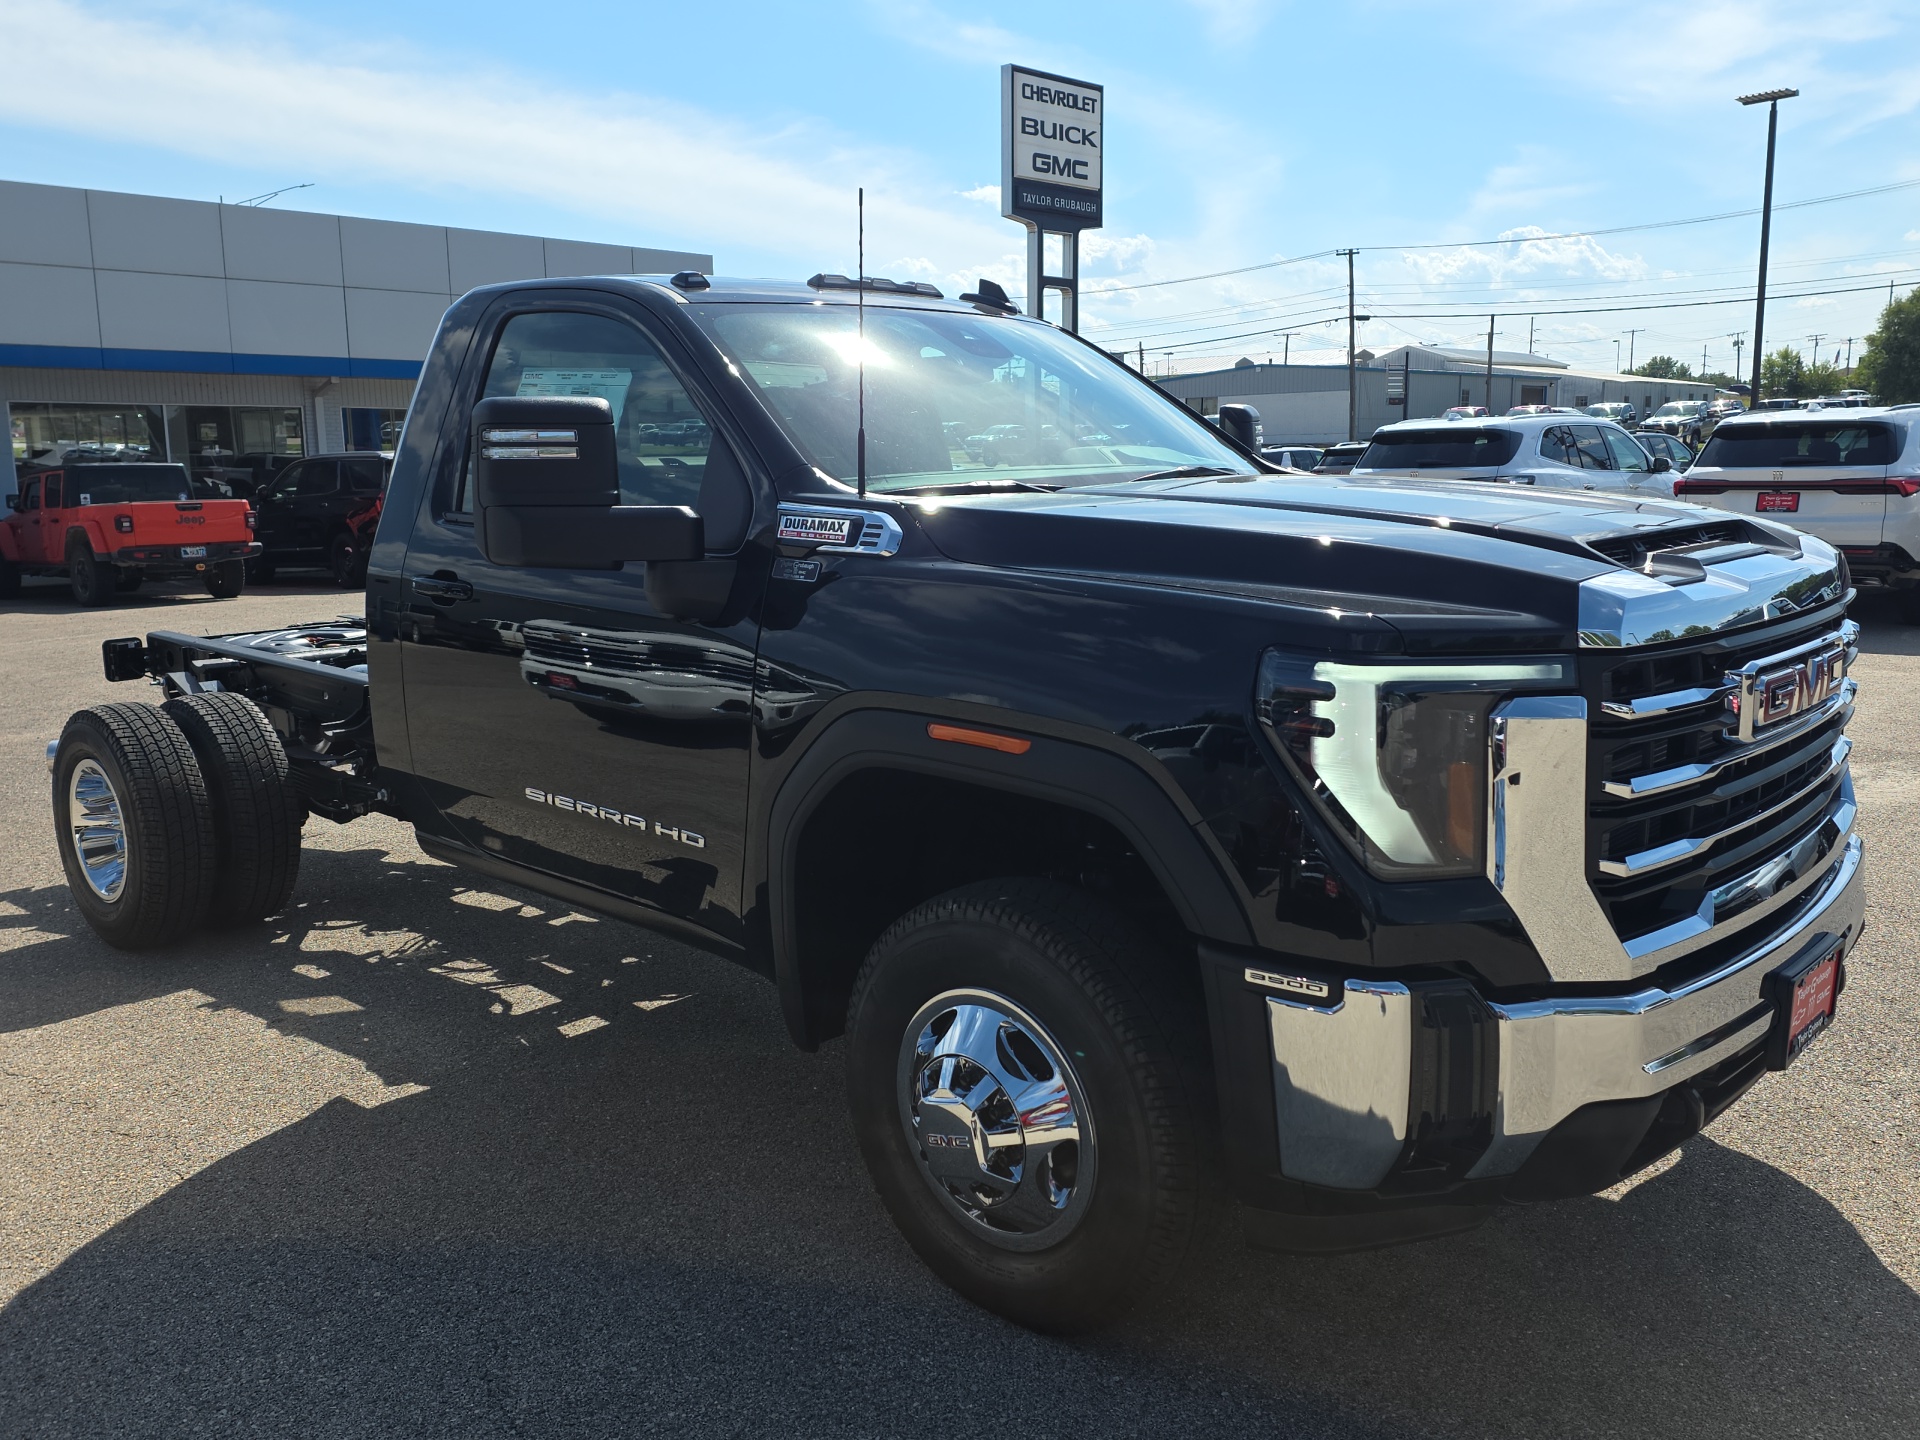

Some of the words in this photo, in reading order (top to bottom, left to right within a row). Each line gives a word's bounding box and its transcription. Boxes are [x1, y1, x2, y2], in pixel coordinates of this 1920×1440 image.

[1022, 82, 1097, 114] CHEVROLET
[1021, 116, 1098, 148] BUICK
[1032, 152, 1088, 180] GMC
[1022, 193, 1052, 206] TAYLOR
[1054, 197, 1097, 213] GRUBAUGH
[175, 514, 206, 525] Jeep
[784, 517, 845, 533] DURAMAX
[1760, 647, 1844, 723] GMC
[525, 787, 646, 831] SIERRA
[655, 822, 705, 848] HD
[1249, 971, 1323, 992] 3500
[927, 1133, 970, 1149] GMC
